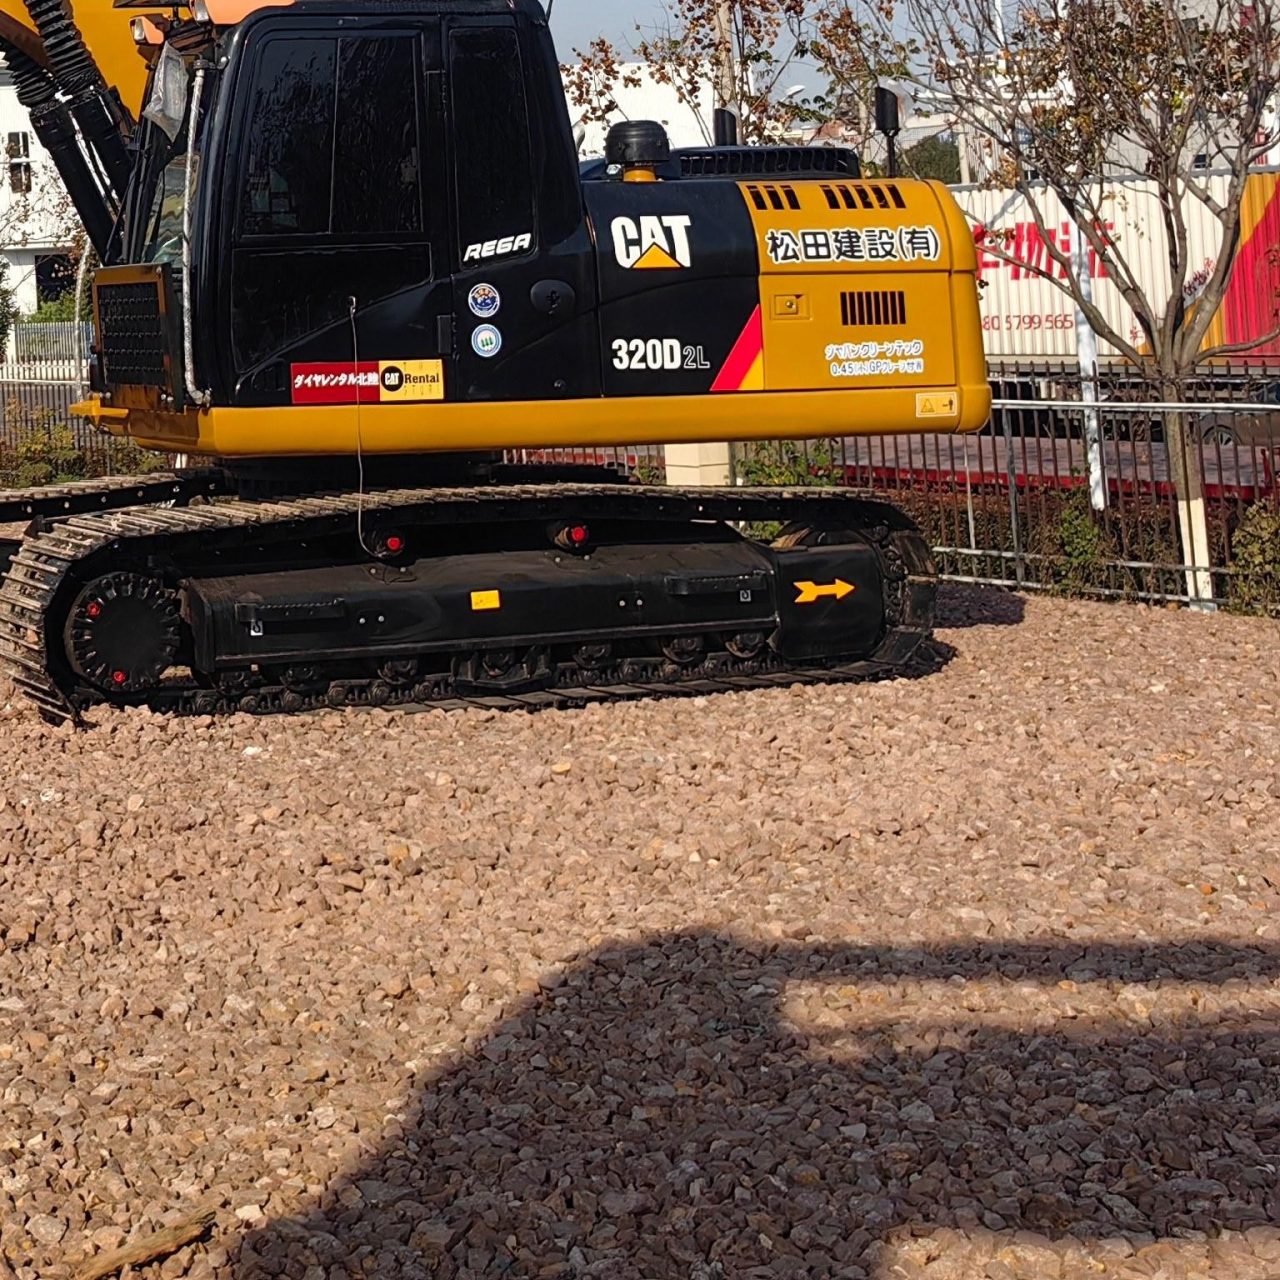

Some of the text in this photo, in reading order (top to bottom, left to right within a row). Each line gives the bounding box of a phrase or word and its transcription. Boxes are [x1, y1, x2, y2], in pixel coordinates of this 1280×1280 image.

[610, 214, 692, 269] CAT
[766, 227, 939, 262] 松田建設(有)
[384, 372, 440, 385] CAT Rental
